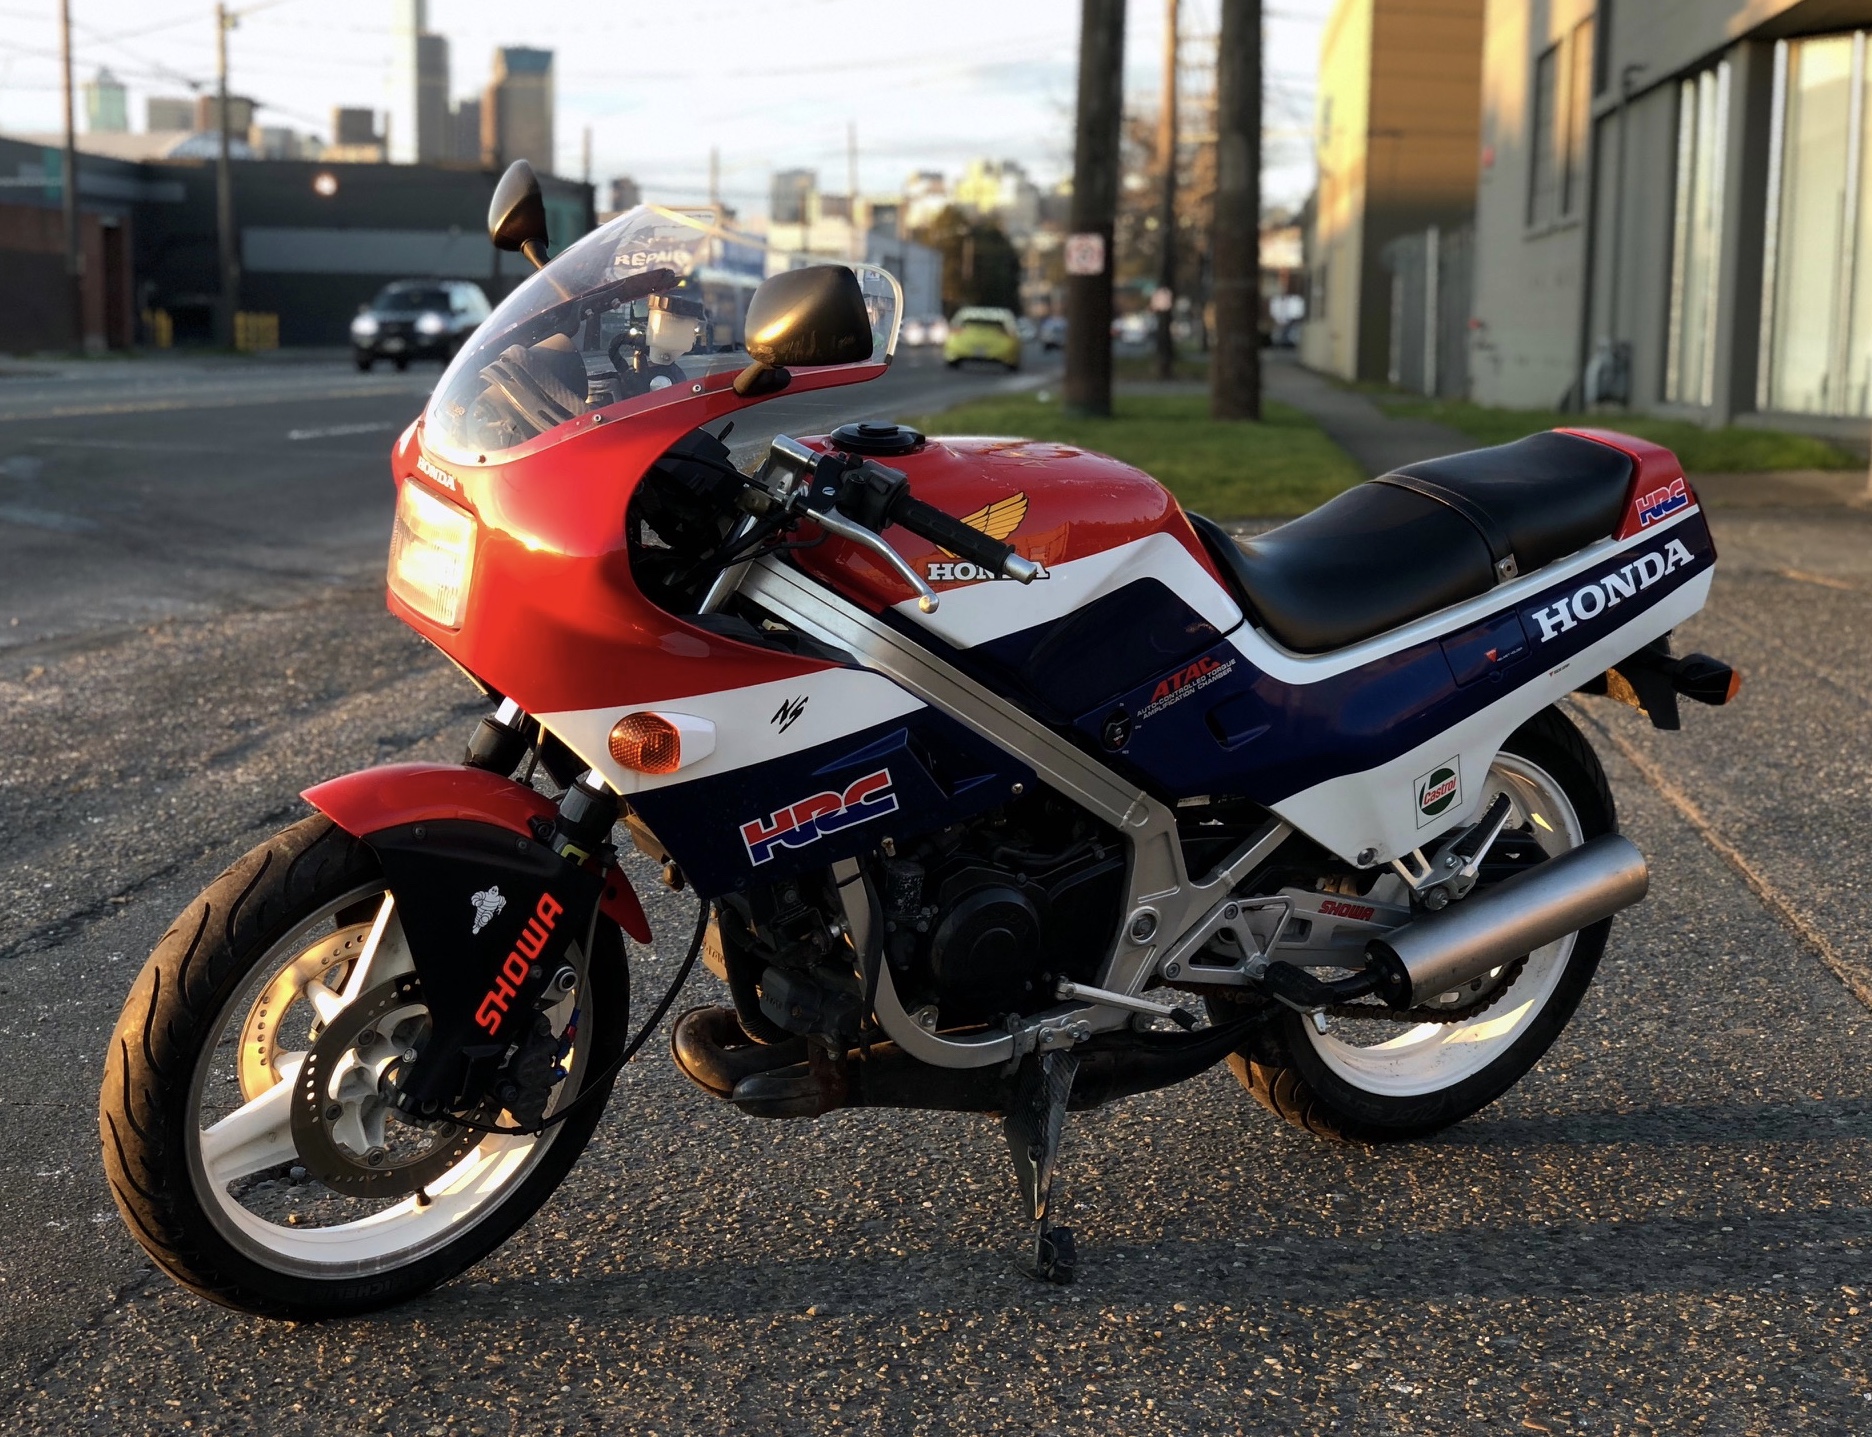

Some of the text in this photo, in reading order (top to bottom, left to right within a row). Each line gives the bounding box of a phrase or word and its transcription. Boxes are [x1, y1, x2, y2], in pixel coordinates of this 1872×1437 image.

[416, 455, 457, 491] HONDA
[1635, 477, 1689, 527] HRC
[927, 560, 1050, 580] HONA
[1532, 538, 1695, 643] HONDA
[1137, 658, 1236, 717] AUTO-CONTROLLED TORQUE
[1143, 667, 1233, 720] AMPLIFICATION CHAMBER
[1150, 656, 1222, 703] ATAC
[770, 694, 809, 735] NS
[1423, 776, 1457, 806] Castrol
[739, 767, 899, 867] HRC
[1318, 900, 1375, 921] SHOWA
[475, 892, 564, 1036] SHOWA
